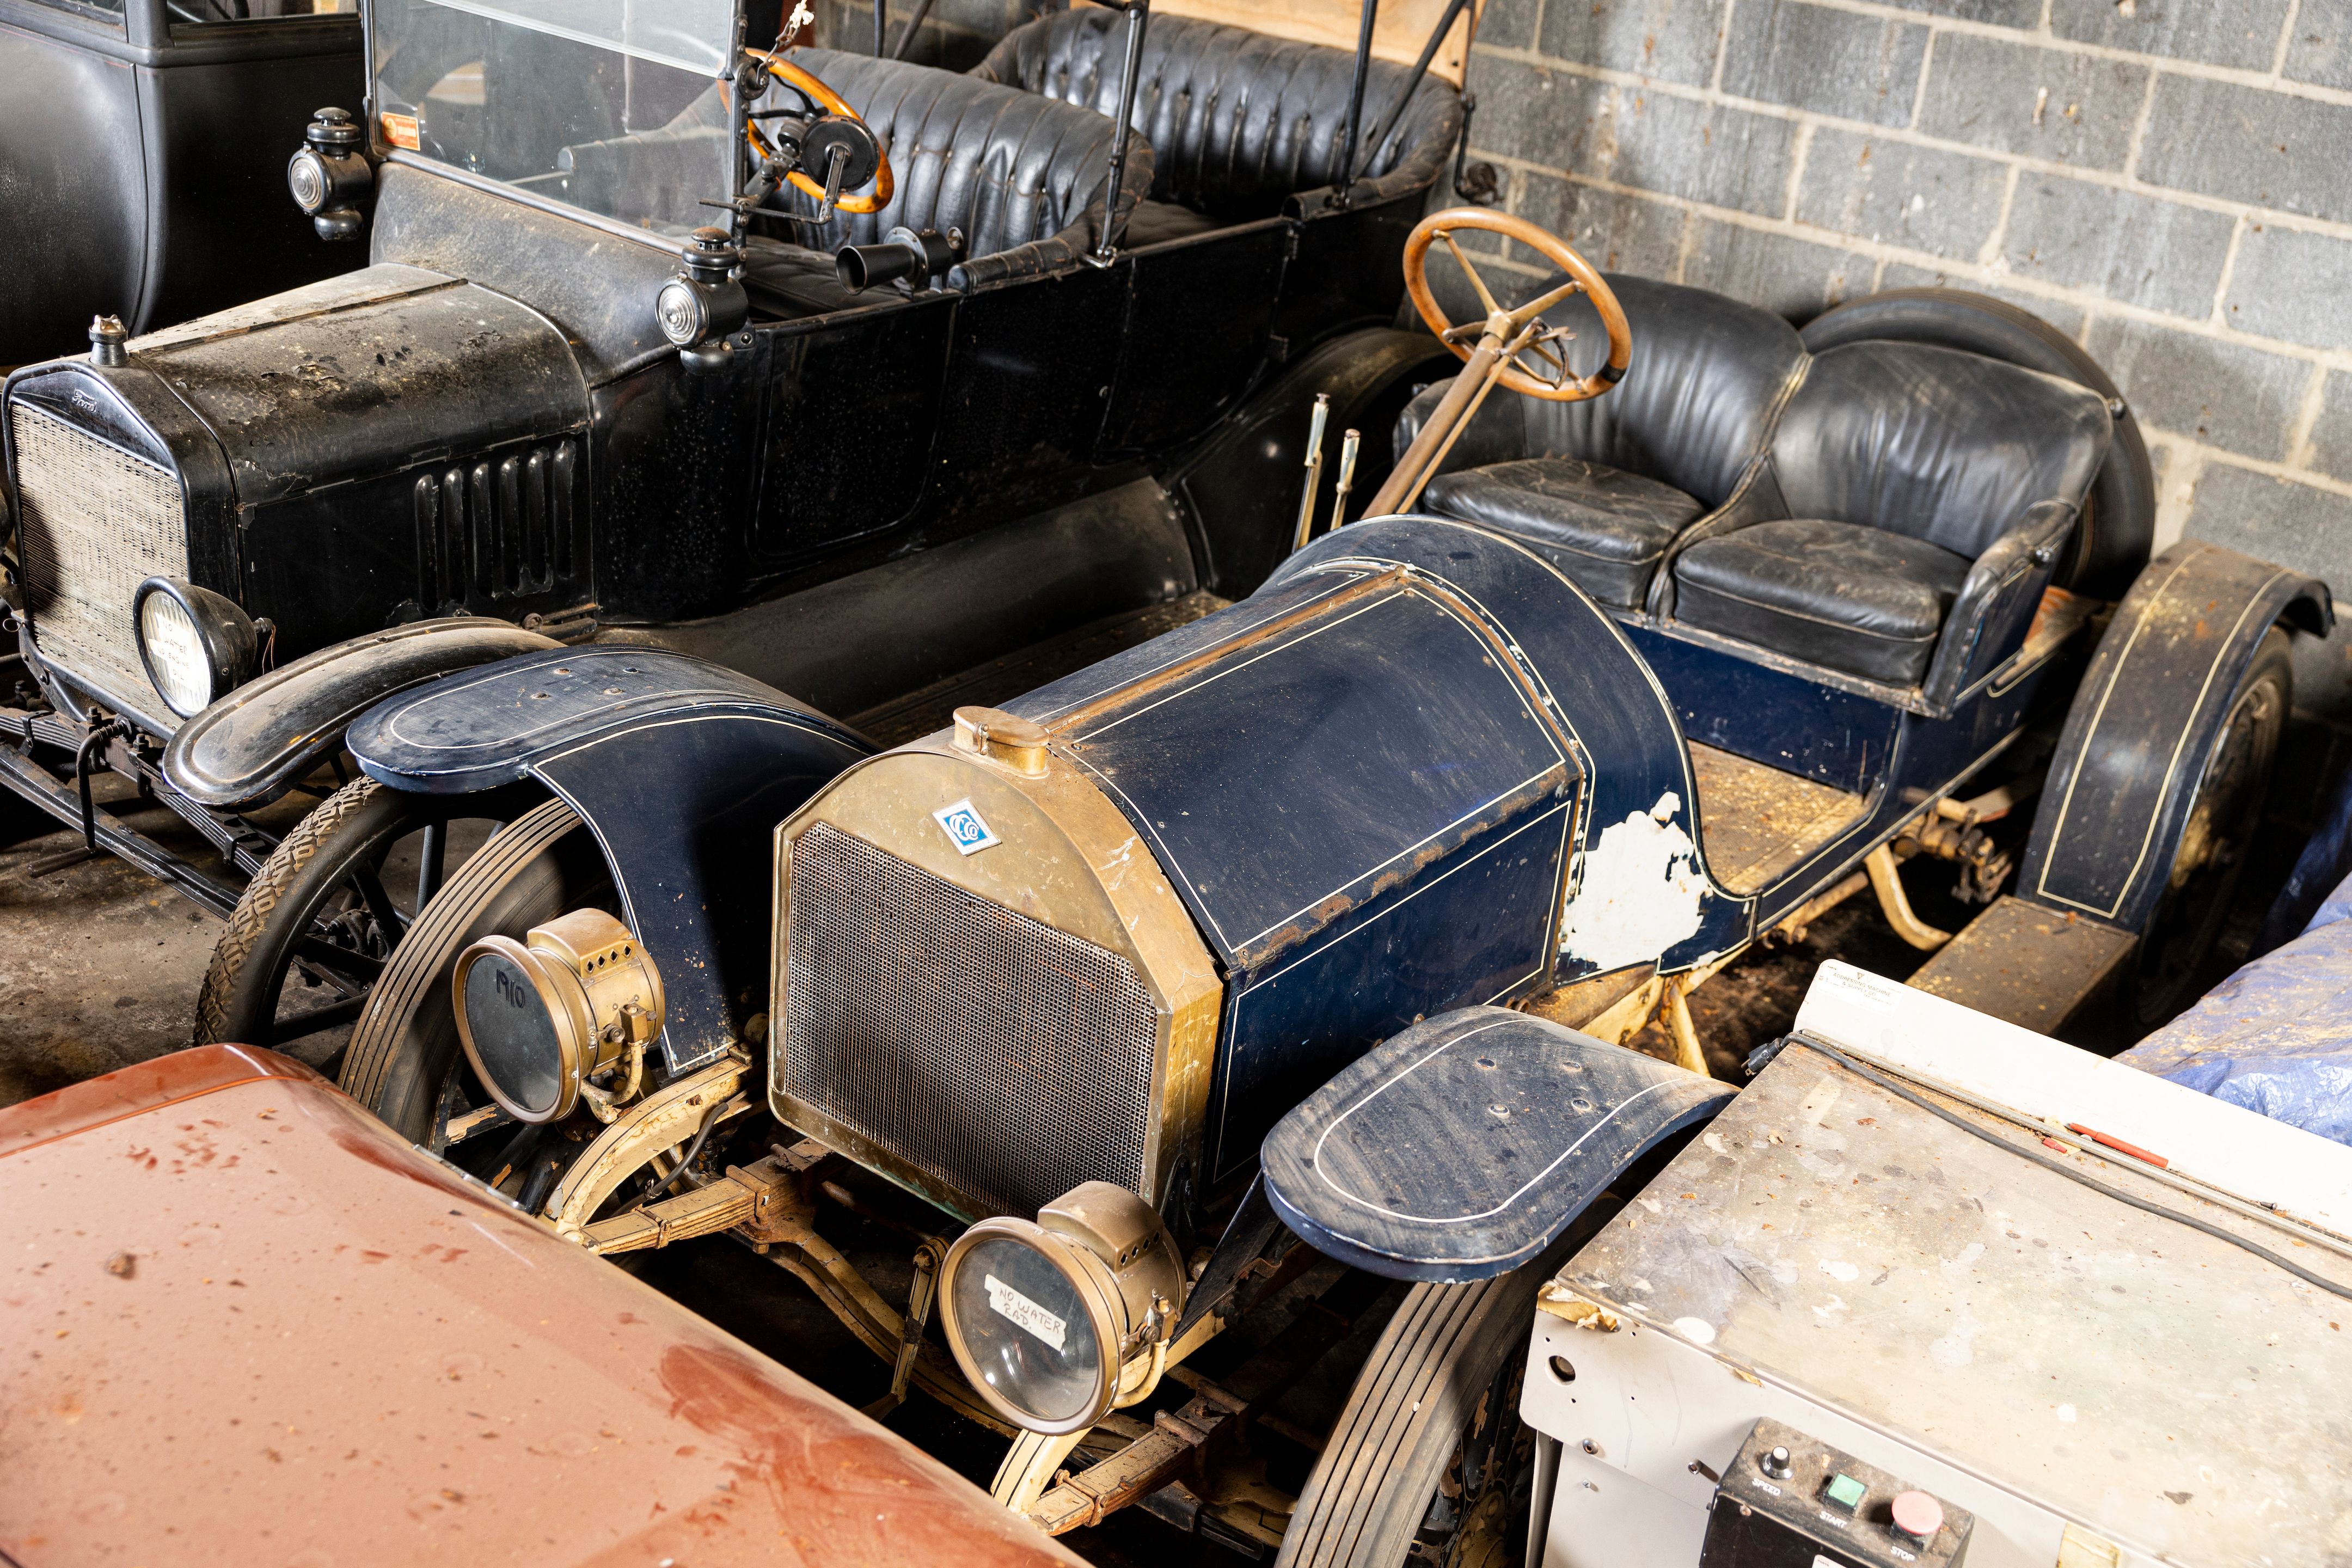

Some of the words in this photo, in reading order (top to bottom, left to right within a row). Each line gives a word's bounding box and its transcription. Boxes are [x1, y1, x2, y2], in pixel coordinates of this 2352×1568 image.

[72, 388, 97, 413] Ford
[163, 623, 173, 632] NO
[164, 639, 188, 656] WATER
[168, 652, 190, 670] ENGINE
[173, 669, 185, 681] OIL
[497, 969, 525, 1008] 1910
[1833, 972, 1866, 988] ADDRESSING
[1867, 984, 1891, 997] MACHINE
[1000, 1288, 1014, 1301] NO
[1018, 1300, 1061, 1333] WATER
[1003, 1303, 1032, 1330] RAD.
[1751, 1478, 1781, 1496] SPEED
[1818, 1510, 1847, 1529] START
[1890, 1545, 1915, 1562] STOP
